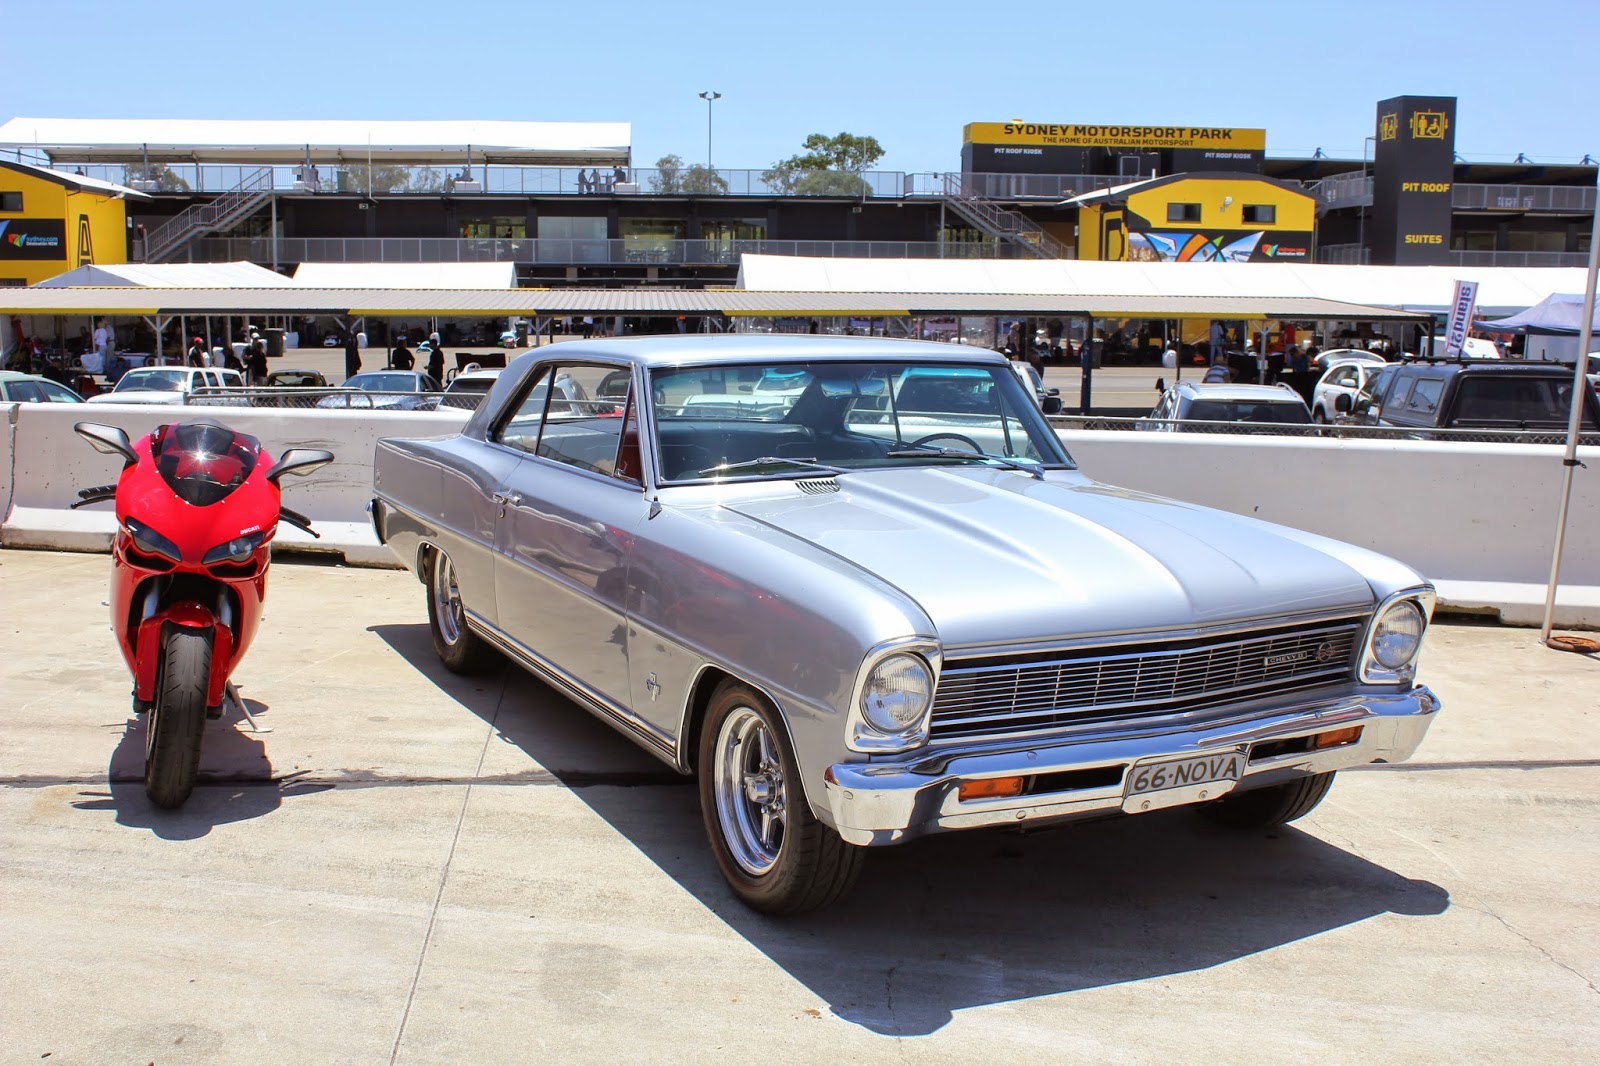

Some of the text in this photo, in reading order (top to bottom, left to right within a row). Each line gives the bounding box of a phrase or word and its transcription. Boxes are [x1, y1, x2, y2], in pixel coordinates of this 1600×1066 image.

[1004, 124, 1232, 139] SYDNEY MOTORSPORT PARK
[1042, 136, 1057, 144] THE
[1142, 138, 1194, 146] MOTORSPORT
[1402, 182, 1450, 193] PIT ROOF
[77, 213, 95, 268] A
[1404, 234, 1443, 244] SUITES
[1450, 286, 1471, 349] stand21
[240, 524, 260, 535] DUCATI
